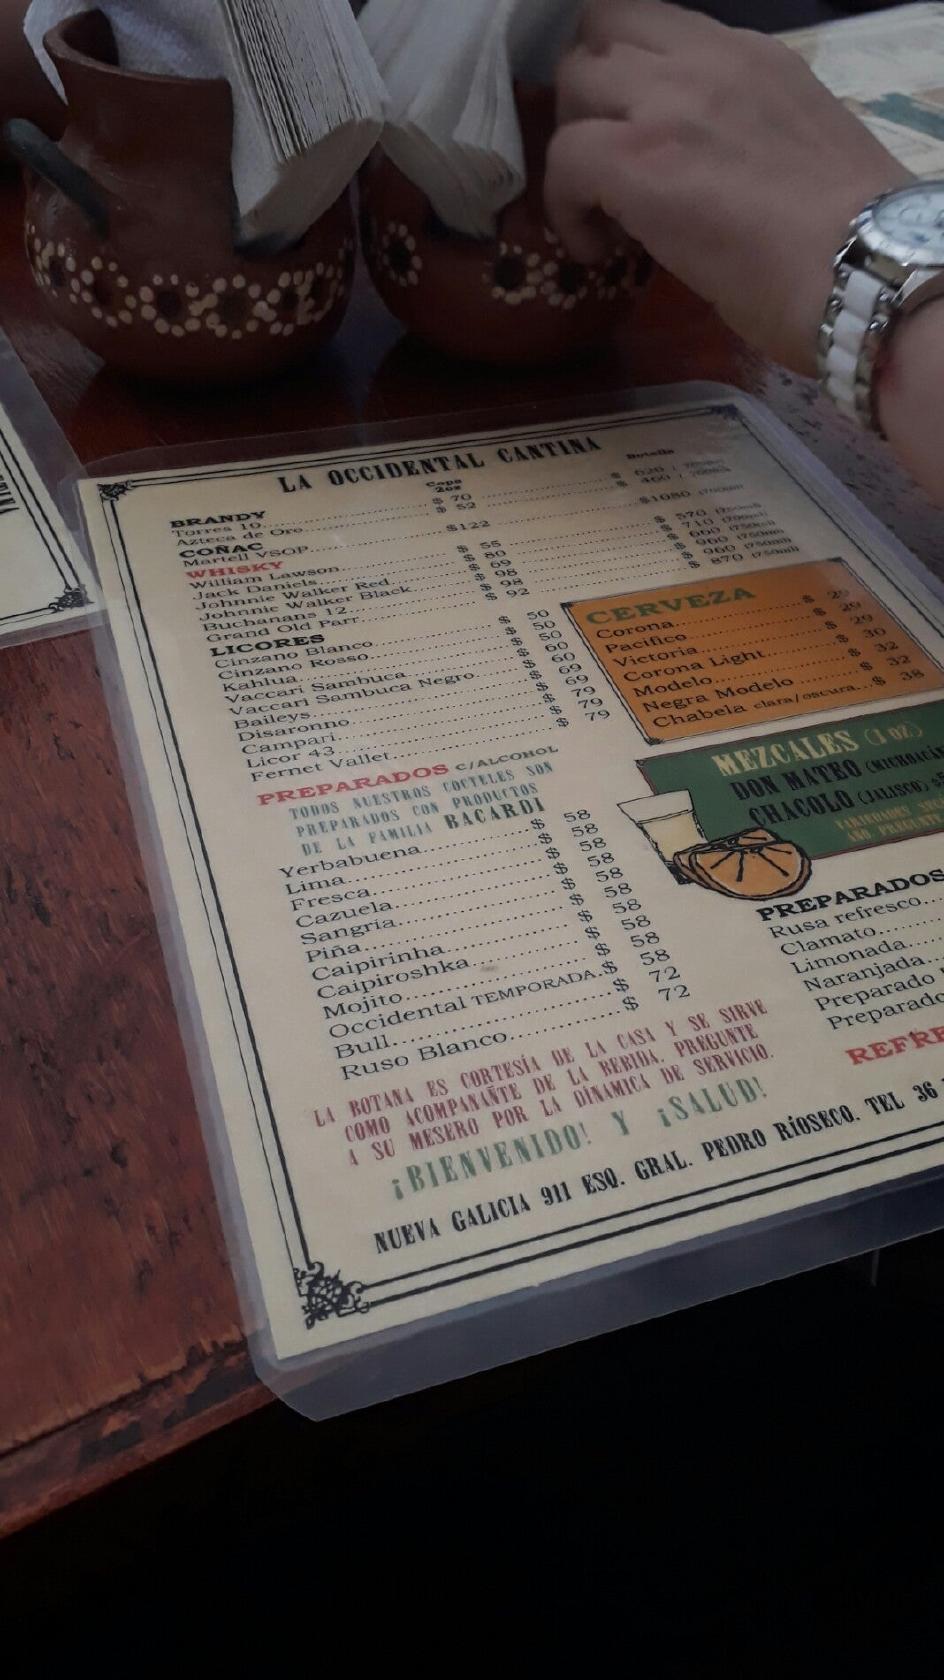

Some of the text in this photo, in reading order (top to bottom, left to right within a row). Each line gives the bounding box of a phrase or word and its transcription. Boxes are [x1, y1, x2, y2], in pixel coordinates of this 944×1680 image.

[277, 436, 602, 494] LA OCCIDENTAL CANTINA
[169, 511, 266, 528] BRANDY
[172, 493, 472, 538] Torres 10 70
[176, 527, 303, 546] Azteca de Oro
[179, 542, 263, 558] COÑAC
[182, 520, 491, 568] Martell VSOP $122
[185, 560, 284, 580] WHISKY
[189, 566, 340, 590] William Lawson
[193, 578, 317, 600] Jack Daniels
[195, 578, 390, 610] Johnnie Walker Red
[199, 585, 410, 621] Johnnie Walker Black
[202, 578, 524, 632] Buchanans 12 98
[586, 587, 756, 625] CERVEZA
[206, 588, 530, 642] Grand Old Parr 92
[596, 620, 674, 639] Corona
[209, 634, 325, 657] LICORES
[214, 640, 373, 669] Cinzano Blanco
[604, 633, 688, 654] Pacifico
[613, 646, 699, 667] Victoria
[218, 653, 369, 680] Cinzano Rosso
[222, 675, 298, 692] Kahlua
[623, 650, 767, 682] Corona Light
[225, 670, 406, 703] Vaccari Sambuca
[229, 672, 475, 716] Vaccari Sambuca Negro
[633, 676, 713, 698] Modelo
[642, 677, 794, 713] Negra Modelo
[234, 711, 311, 731] Baileys
[238, 718, 350, 742] Disaronno
[653, 702, 747, 728] Chabela
[242, 731, 336, 755] Campari
[246, 746, 336, 768] Licor 43
[251, 709, 611, 782] Fernet Vallet 79
[711, 730, 860, 776] MEZCALES
[256, 745, 558, 807] PREPARADOS C/ALCOHOL
[289, 760, 554, 820] TODOS NUESTROS COCTELES SON
[729, 775, 780, 801] DON
[781, 759, 863, 791] MATEO
[296, 782, 539, 838] PREPARADOS CON PRODUCTOS
[749, 790, 855, 827] CHACOLO
[858, 779, 929, 805] (JALISCO)
[279, 809, 591, 879] Yerbabuena 58
[301, 796, 546, 856] DE LA FAMILIA BACARDI
[286, 875, 346, 895] Lima
[290, 888, 371, 912] Fresca
[755, 869, 944, 922] PREPARADOS
[295, 901, 394, 928] Cazuela
[768, 897, 922, 938] Rusa refresco
[306, 942, 362, 963] Piña
[780, 927, 876, 956] Clamato
[790, 939, 907, 975] Limonada
[312, 943, 446, 981] Caipirinha
[317, 957, 471, 1000] Caipiroshka
[803, 954, 926, 992] Naranjada
[322, 992, 403, 1020] Mojito
[329, 949, 671, 1039] Occidental TEMPORADA 58
[814, 974, 935, 1011] Preparado
[334, 966, 681, 1060] Bull 72
[341, 984, 691, 1081] Ruso Blanco 72
[313, 998, 768, 1128] LA BOTANA ES CORTESÍA DE LA CASA Y SE SIRVE
[344, 1115, 391, 1143] COMO
[532, 1073, 556, 1096] DE
[567, 1066, 590, 1086] LA
[598, 1048, 665, 1077] BEBIDA.
[673, 1022, 760, 1058] PREGUNTE
[348, 1148, 359, 1166] A
[371, 1138, 396, 1161] SU
[408, 1117, 480, 1151] MESERO
[492, 1104, 530, 1130] POR
[539, 1095, 563, 1118] LA
[660, 1064, 685, 1085] DE
[692, 1042, 774, 1076] SERVICIO.
[391, 1076, 768, 1201] ¡BIENVENIDO! Y ¡SALUD!
[373, 1217, 441, 1254] NUEVA
[451, 1193, 531, 1232] GALICIA
[540, 1181, 572, 1206] 911
[582, 1166, 626, 1195] ESQ.
[634, 1150, 693, 1181] GRAL.
[701, 1128, 768, 1161] PEDRO
[864, 1091, 905, 1115] TEL
[912, 1081, 939, 1102] 36
